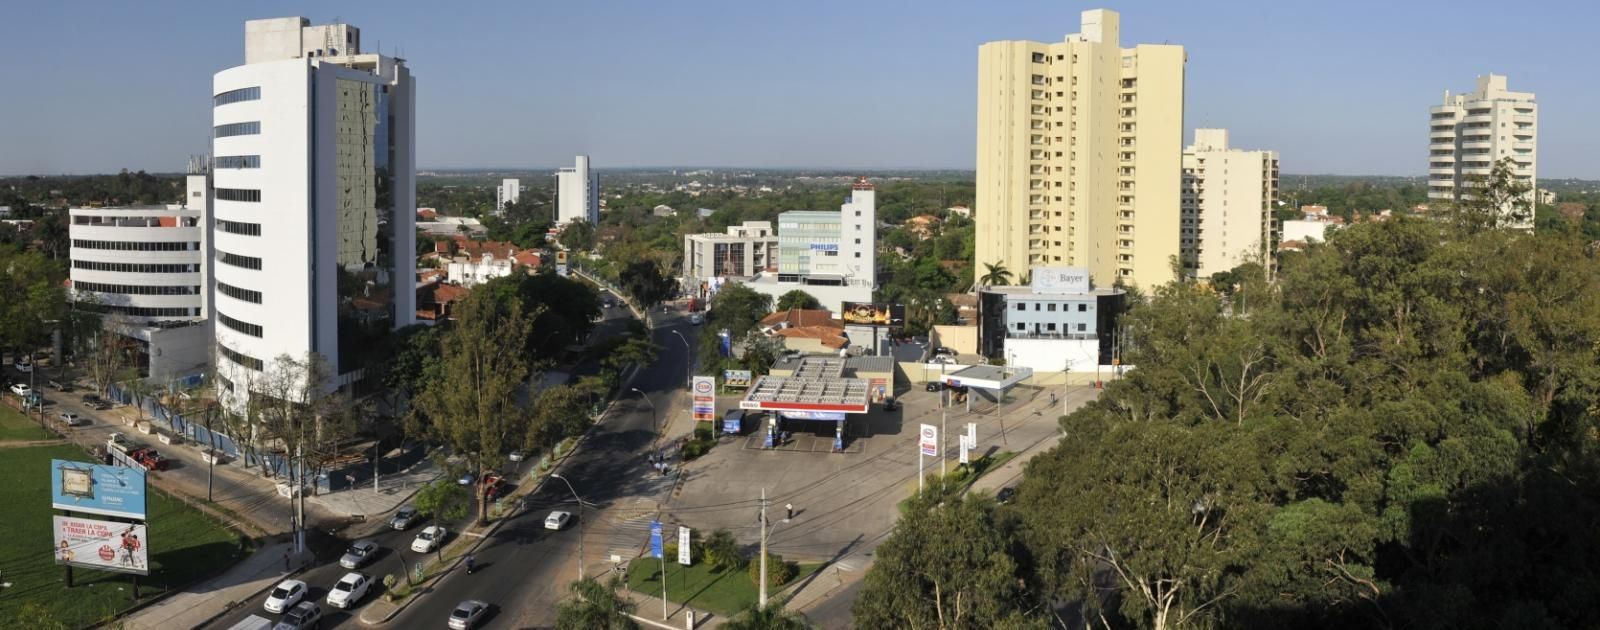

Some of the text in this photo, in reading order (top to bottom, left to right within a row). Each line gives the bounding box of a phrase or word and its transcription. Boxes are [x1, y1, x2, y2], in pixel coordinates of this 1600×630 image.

[1060, 273, 1083, 284] Bayer
[67, 527, 86, 535] TRAER
[97, 530, 113, 538] COPA
